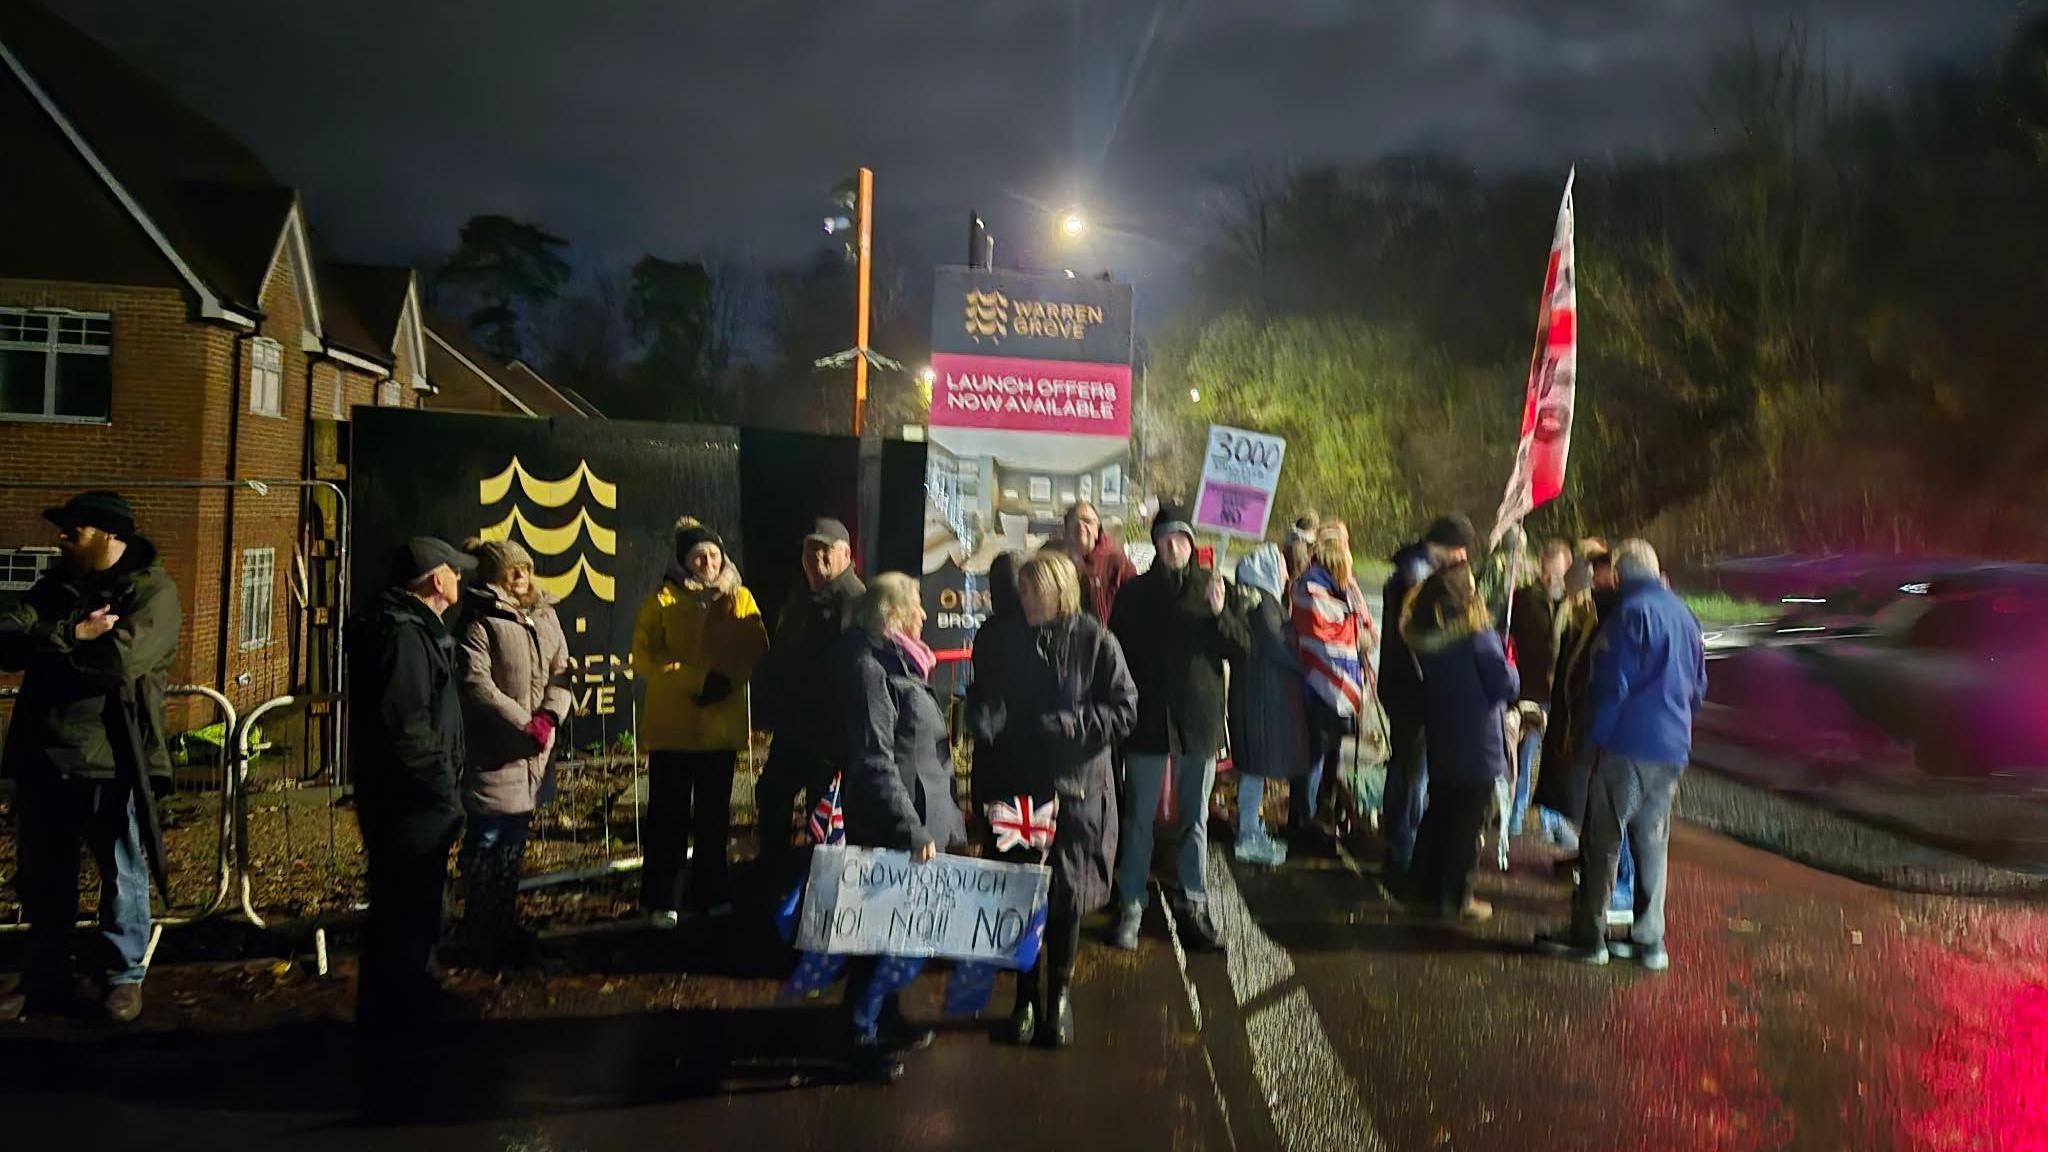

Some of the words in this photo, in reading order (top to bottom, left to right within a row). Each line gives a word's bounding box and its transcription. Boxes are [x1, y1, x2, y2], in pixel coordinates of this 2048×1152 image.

[1013, 300, 1103, 325] WARREN
[1014, 316, 1085, 340] GROVE
[946, 373, 1034, 396] LAUNCH
[1037, 378, 1117, 401] OFFERS
[946, 391, 1002, 413] NOW
[1005, 396, 1114, 420] AVAILABLE
[1213, 431, 1280, 471] 3000
[842, 857, 1007, 897] CROWBOROUGH
